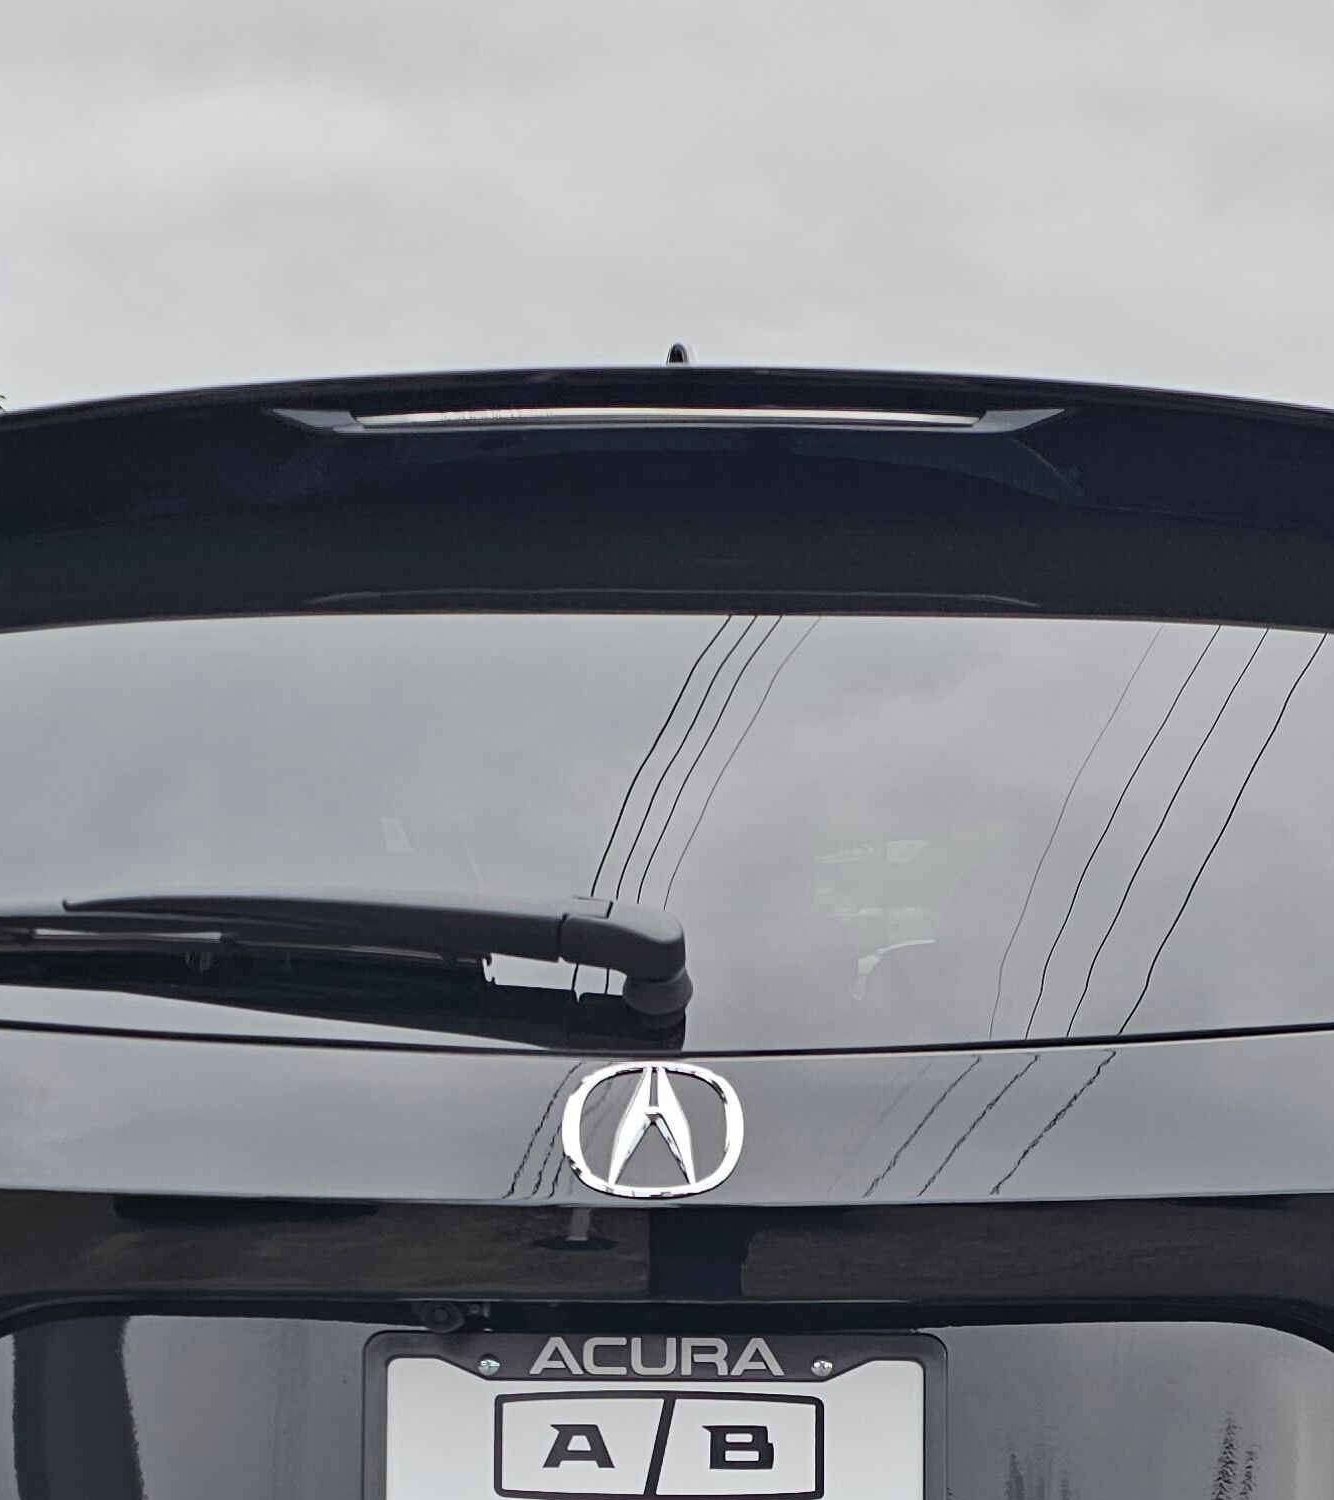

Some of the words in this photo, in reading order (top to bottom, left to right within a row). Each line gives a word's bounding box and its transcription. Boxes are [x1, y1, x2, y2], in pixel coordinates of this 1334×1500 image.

[529, 1336, 784, 1377] ACURA
[542, 1423, 615, 1469] A
[701, 1424, 775, 1471] B
